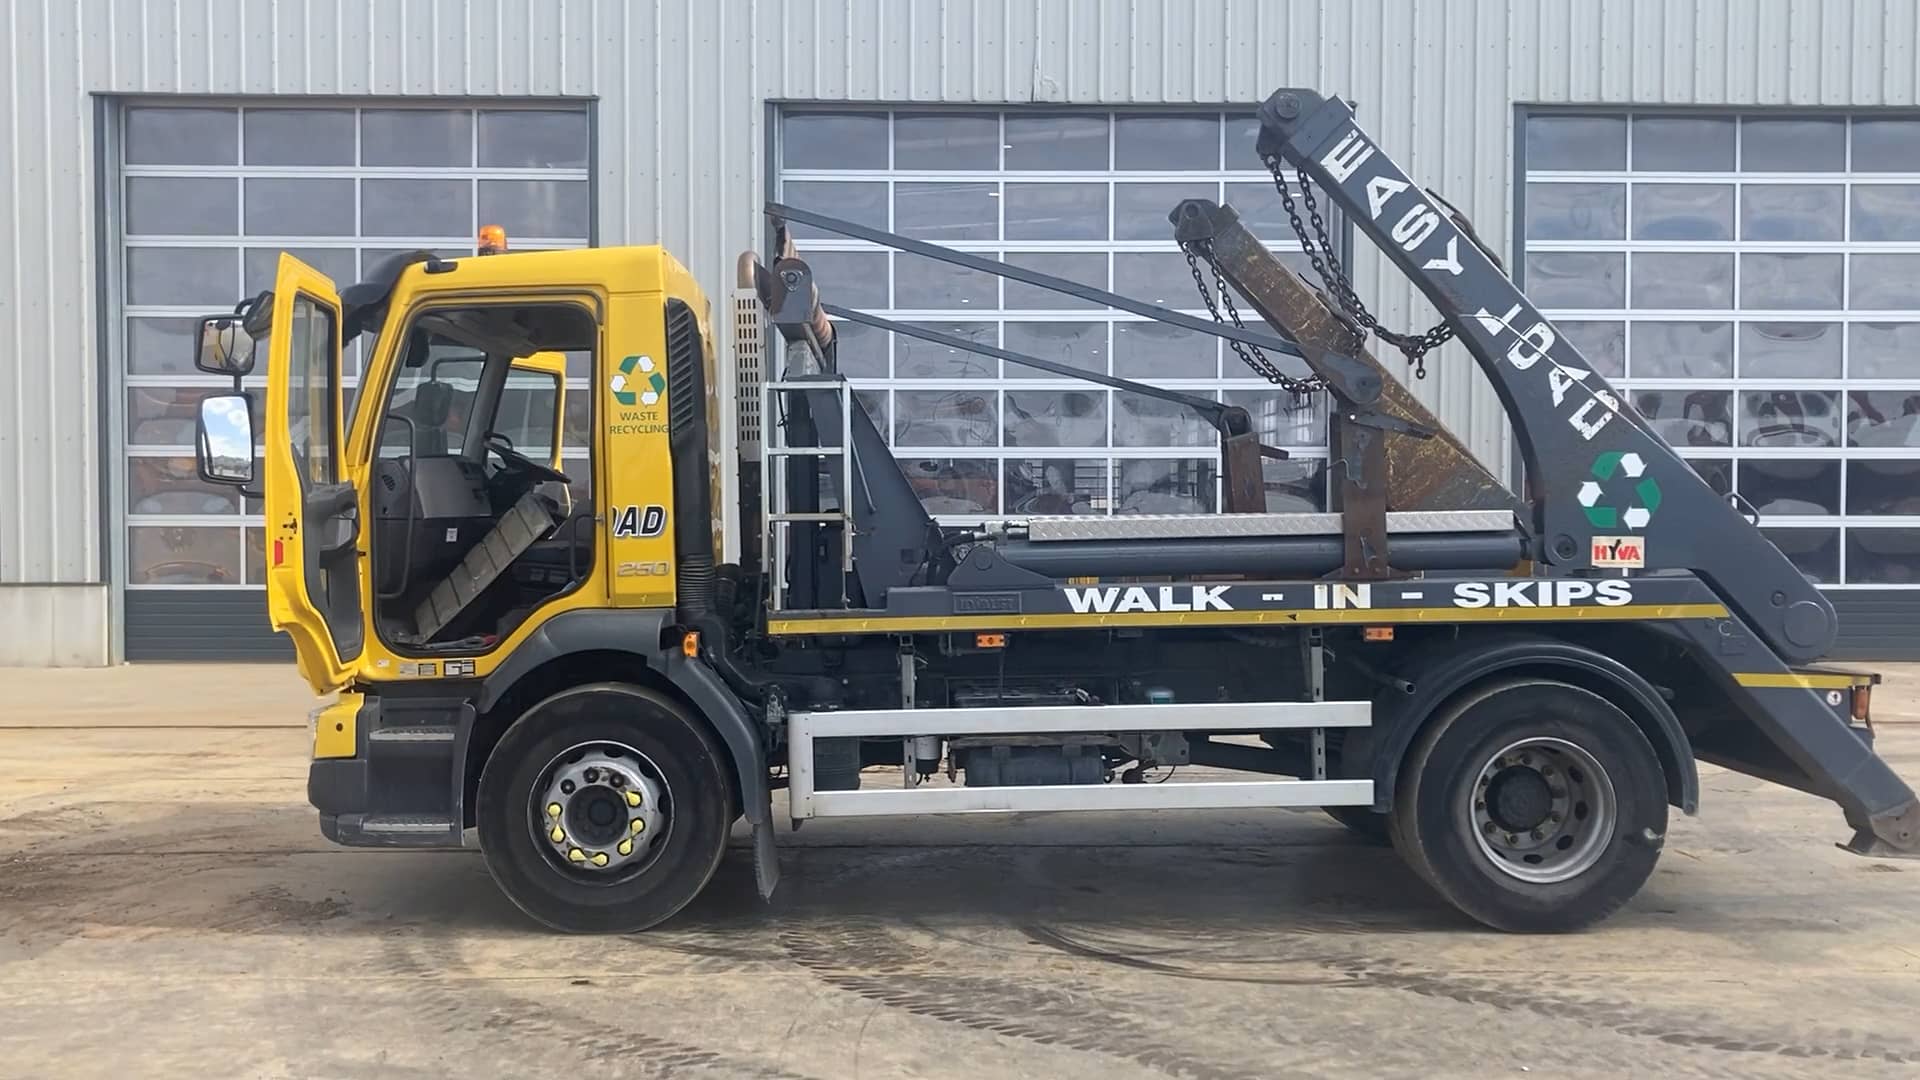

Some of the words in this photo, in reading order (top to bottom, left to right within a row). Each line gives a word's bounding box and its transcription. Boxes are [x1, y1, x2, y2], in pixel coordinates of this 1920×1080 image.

[1320, 130, 1464, 276] EASY
[1473, 303, 1620, 440] LOAD
[620, 411, 659, 421] WASTE
[609, 424, 669, 434] RECYCLING
[612, 504, 666, 537] AD
[1594, 539, 1641, 560] HYVA
[617, 561, 669, 577] 250
[1063, 585, 1234, 613] WALK
[1314, 584, 1371, 610] IN
[1453, 580, 1633, 608] SKIPS
